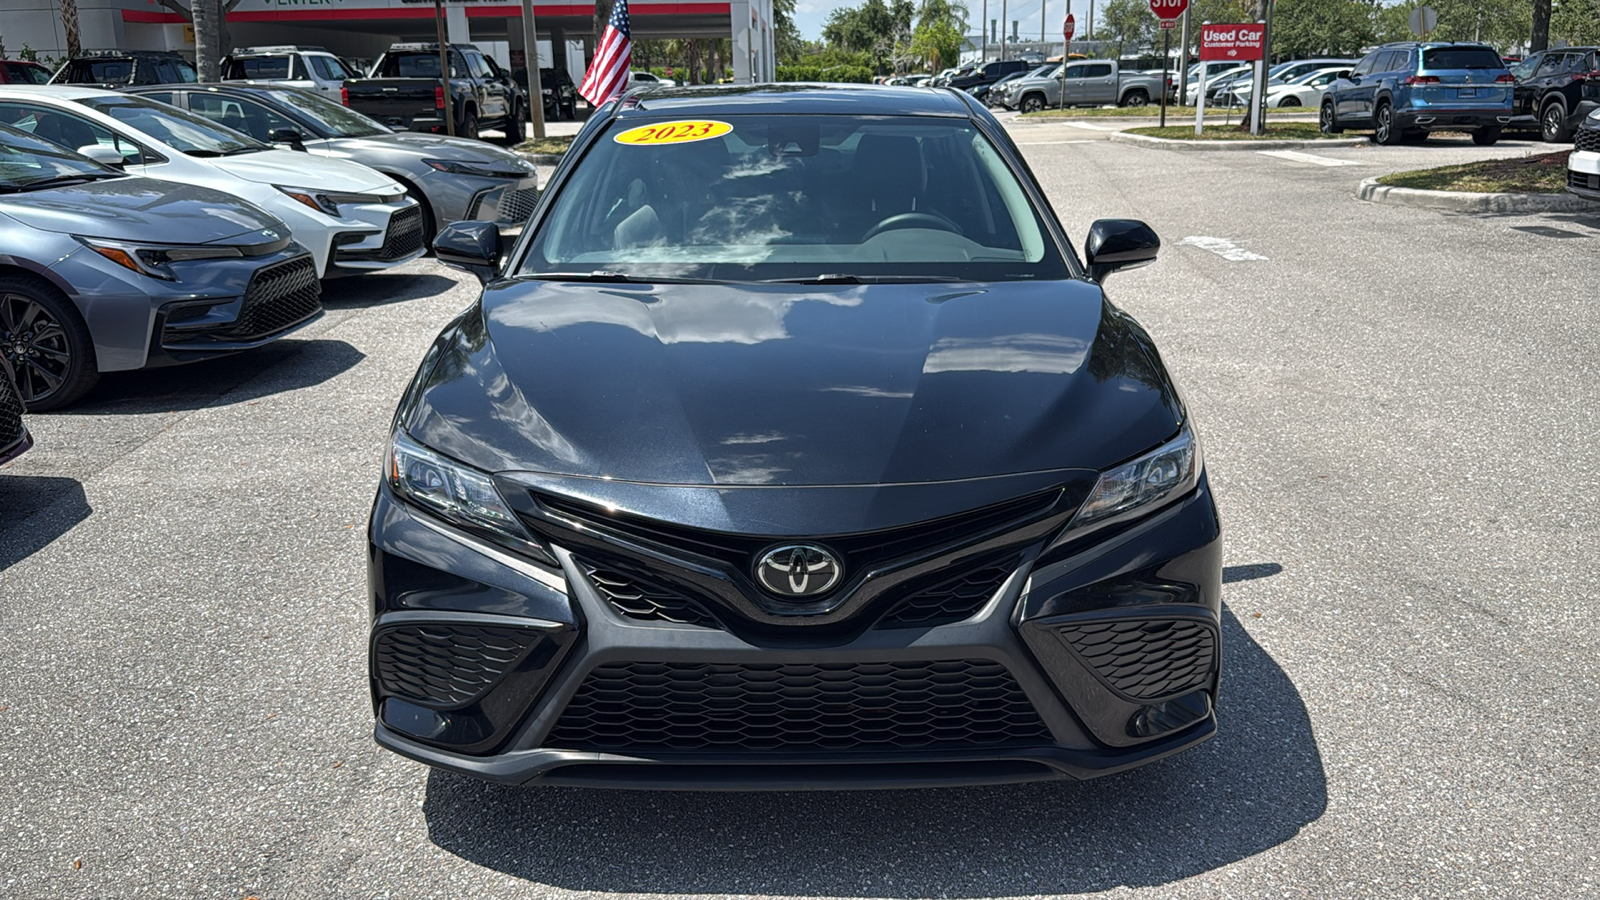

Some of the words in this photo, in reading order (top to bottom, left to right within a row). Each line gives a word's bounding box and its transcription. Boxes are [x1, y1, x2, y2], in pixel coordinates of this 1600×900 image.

[1203, 30, 1235, 41] Used
[1239, 29, 1262, 41] Car
[633, 123, 714, 142] 2023
